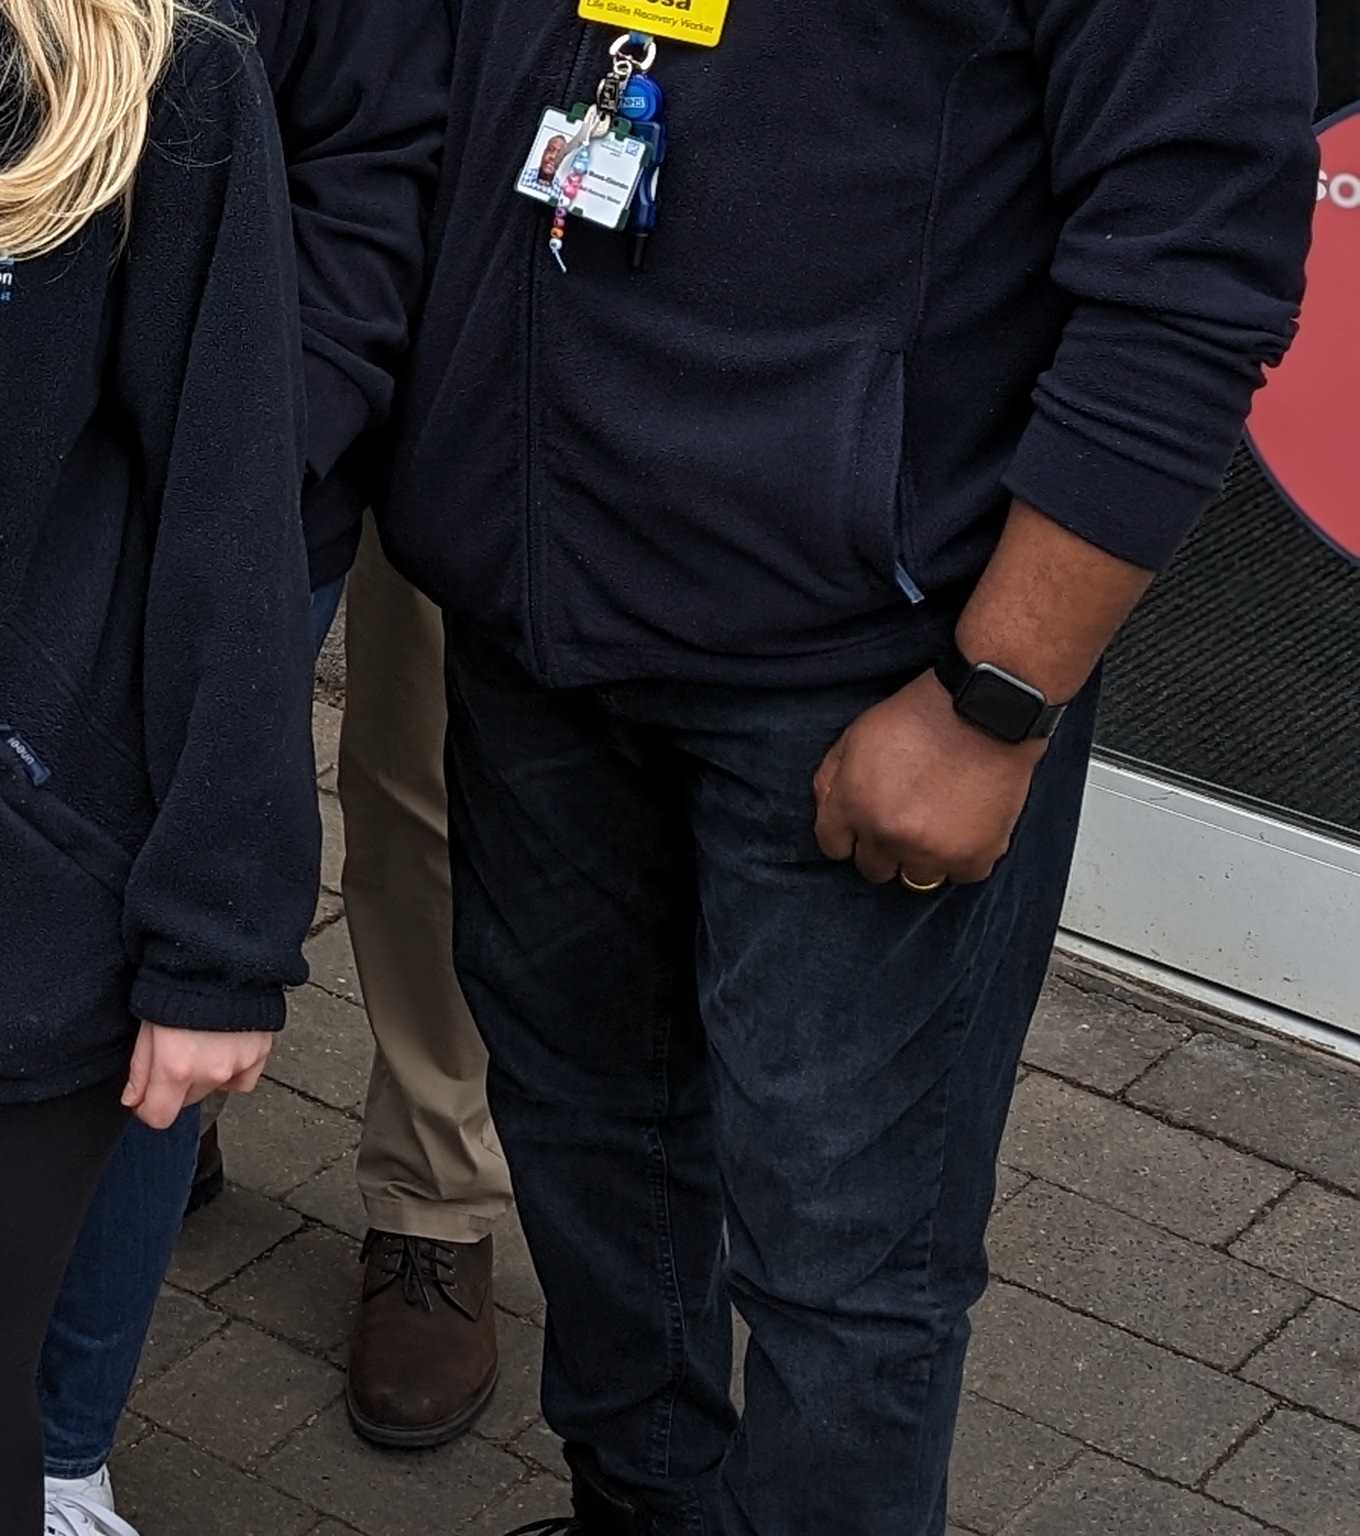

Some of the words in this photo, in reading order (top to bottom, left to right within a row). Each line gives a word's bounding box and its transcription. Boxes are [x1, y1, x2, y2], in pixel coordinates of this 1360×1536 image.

[606, 2, 631, 15] Skills
[633, 7, 679, 28] Recovery
[680, 17, 715, 34] Worker
